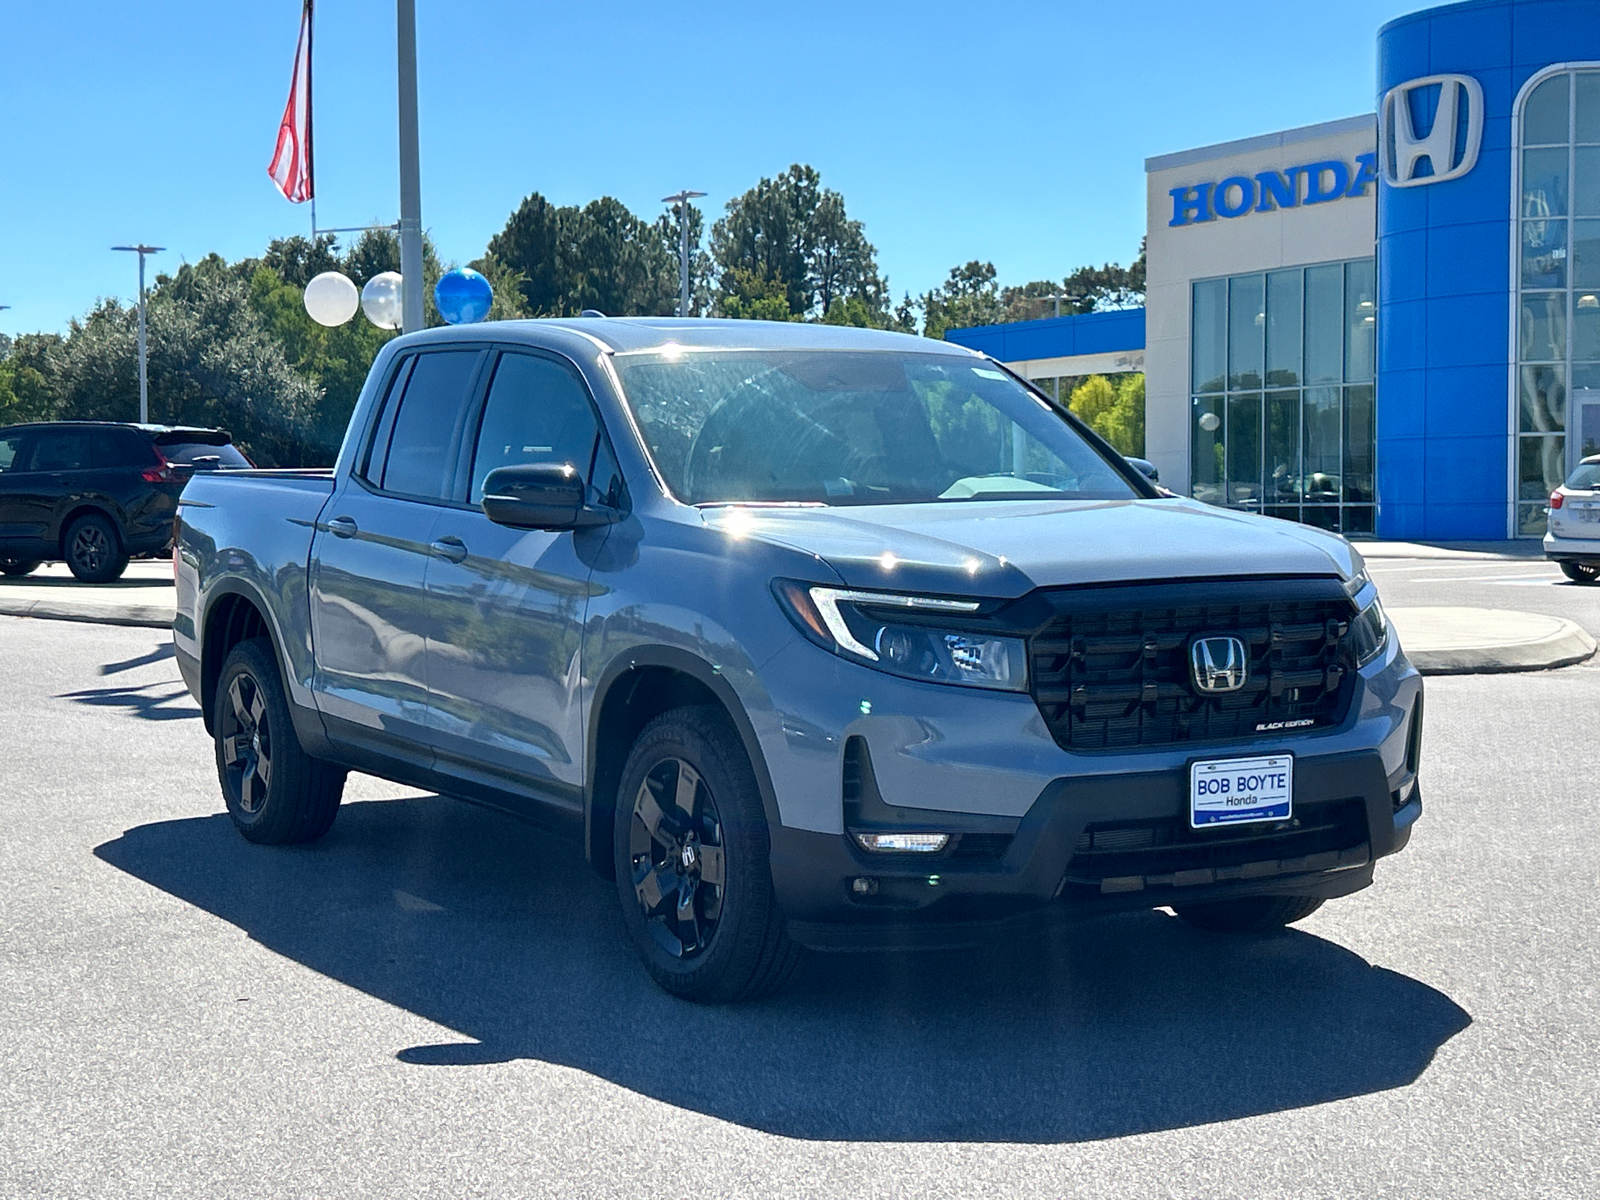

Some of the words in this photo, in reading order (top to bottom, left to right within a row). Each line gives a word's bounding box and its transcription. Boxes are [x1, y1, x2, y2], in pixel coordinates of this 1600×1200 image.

[1169, 152, 1377, 227] HONDA
[1256, 721, 1285, 731] BLACK
[1285, 719, 1314, 728] EDITION
[1197, 778, 1230, 796] BOB
[1237, 773, 1286, 792] BOYTE
[1226, 794, 1258, 807] Honda
